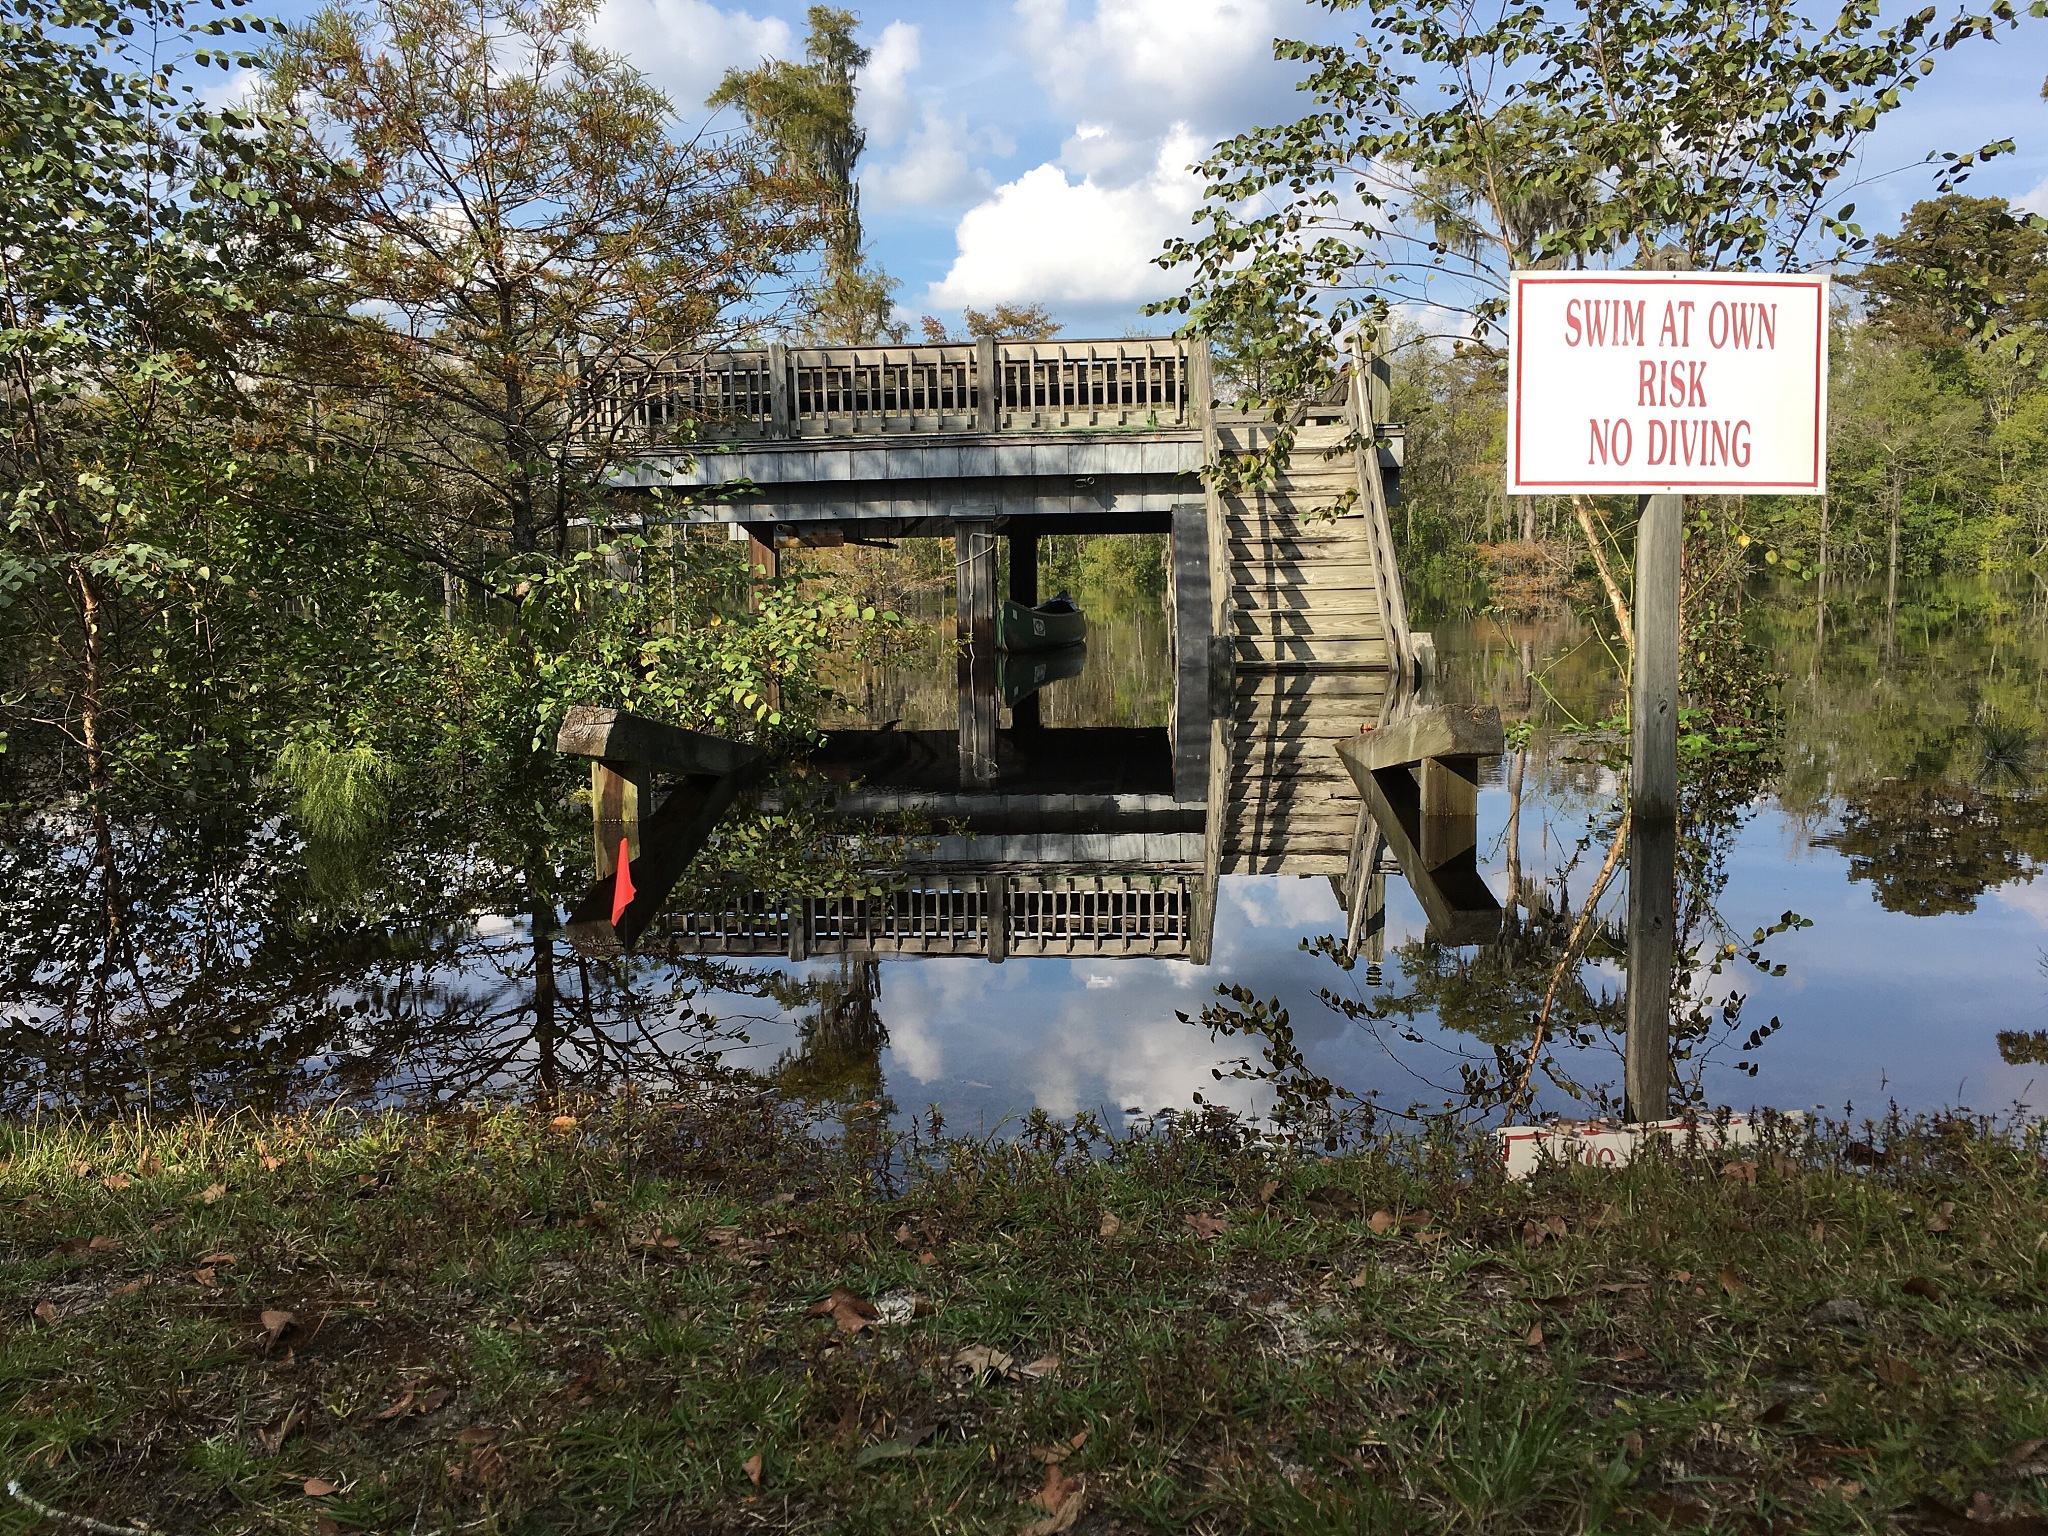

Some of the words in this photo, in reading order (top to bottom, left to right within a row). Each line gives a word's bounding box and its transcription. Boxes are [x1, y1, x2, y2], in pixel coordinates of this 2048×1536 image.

[1565, 298, 1646, 347] SWIM
[1659, 300, 1695, 348] AT
[1708, 301, 1777, 350] OWN
[1637, 359, 1707, 408] RISK
[1588, 417, 1633, 466] NO
[1647, 419, 1752, 468] DIVING
